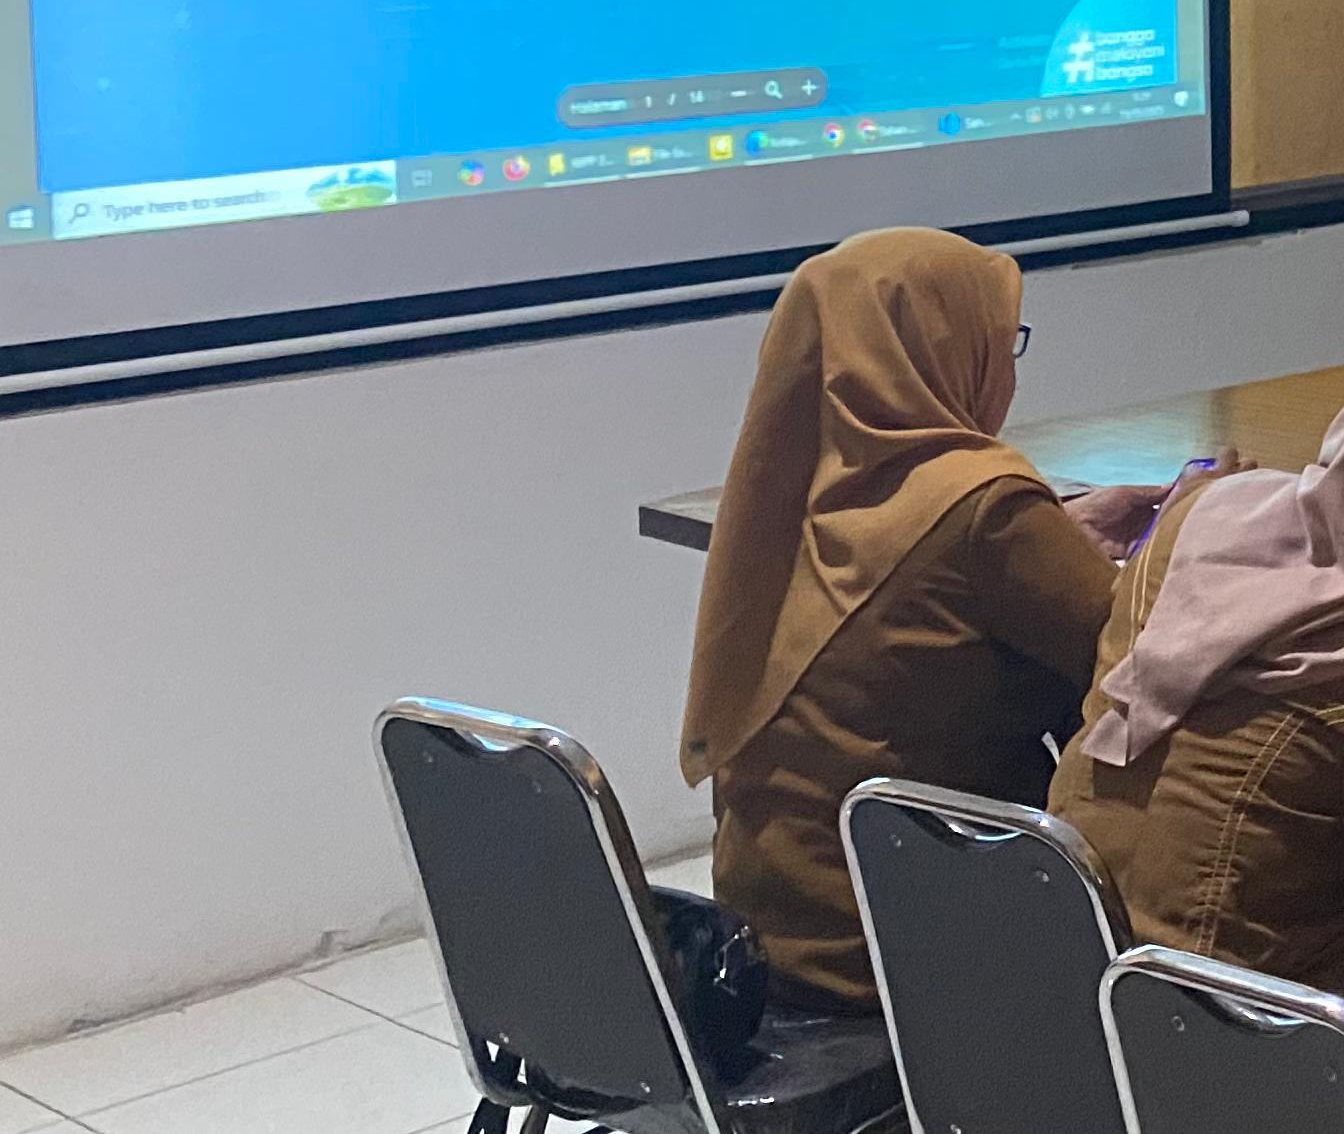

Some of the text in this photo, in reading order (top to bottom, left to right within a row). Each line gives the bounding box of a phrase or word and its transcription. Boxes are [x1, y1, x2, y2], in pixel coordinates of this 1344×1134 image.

[104, 190, 266, 222] Type here to search
